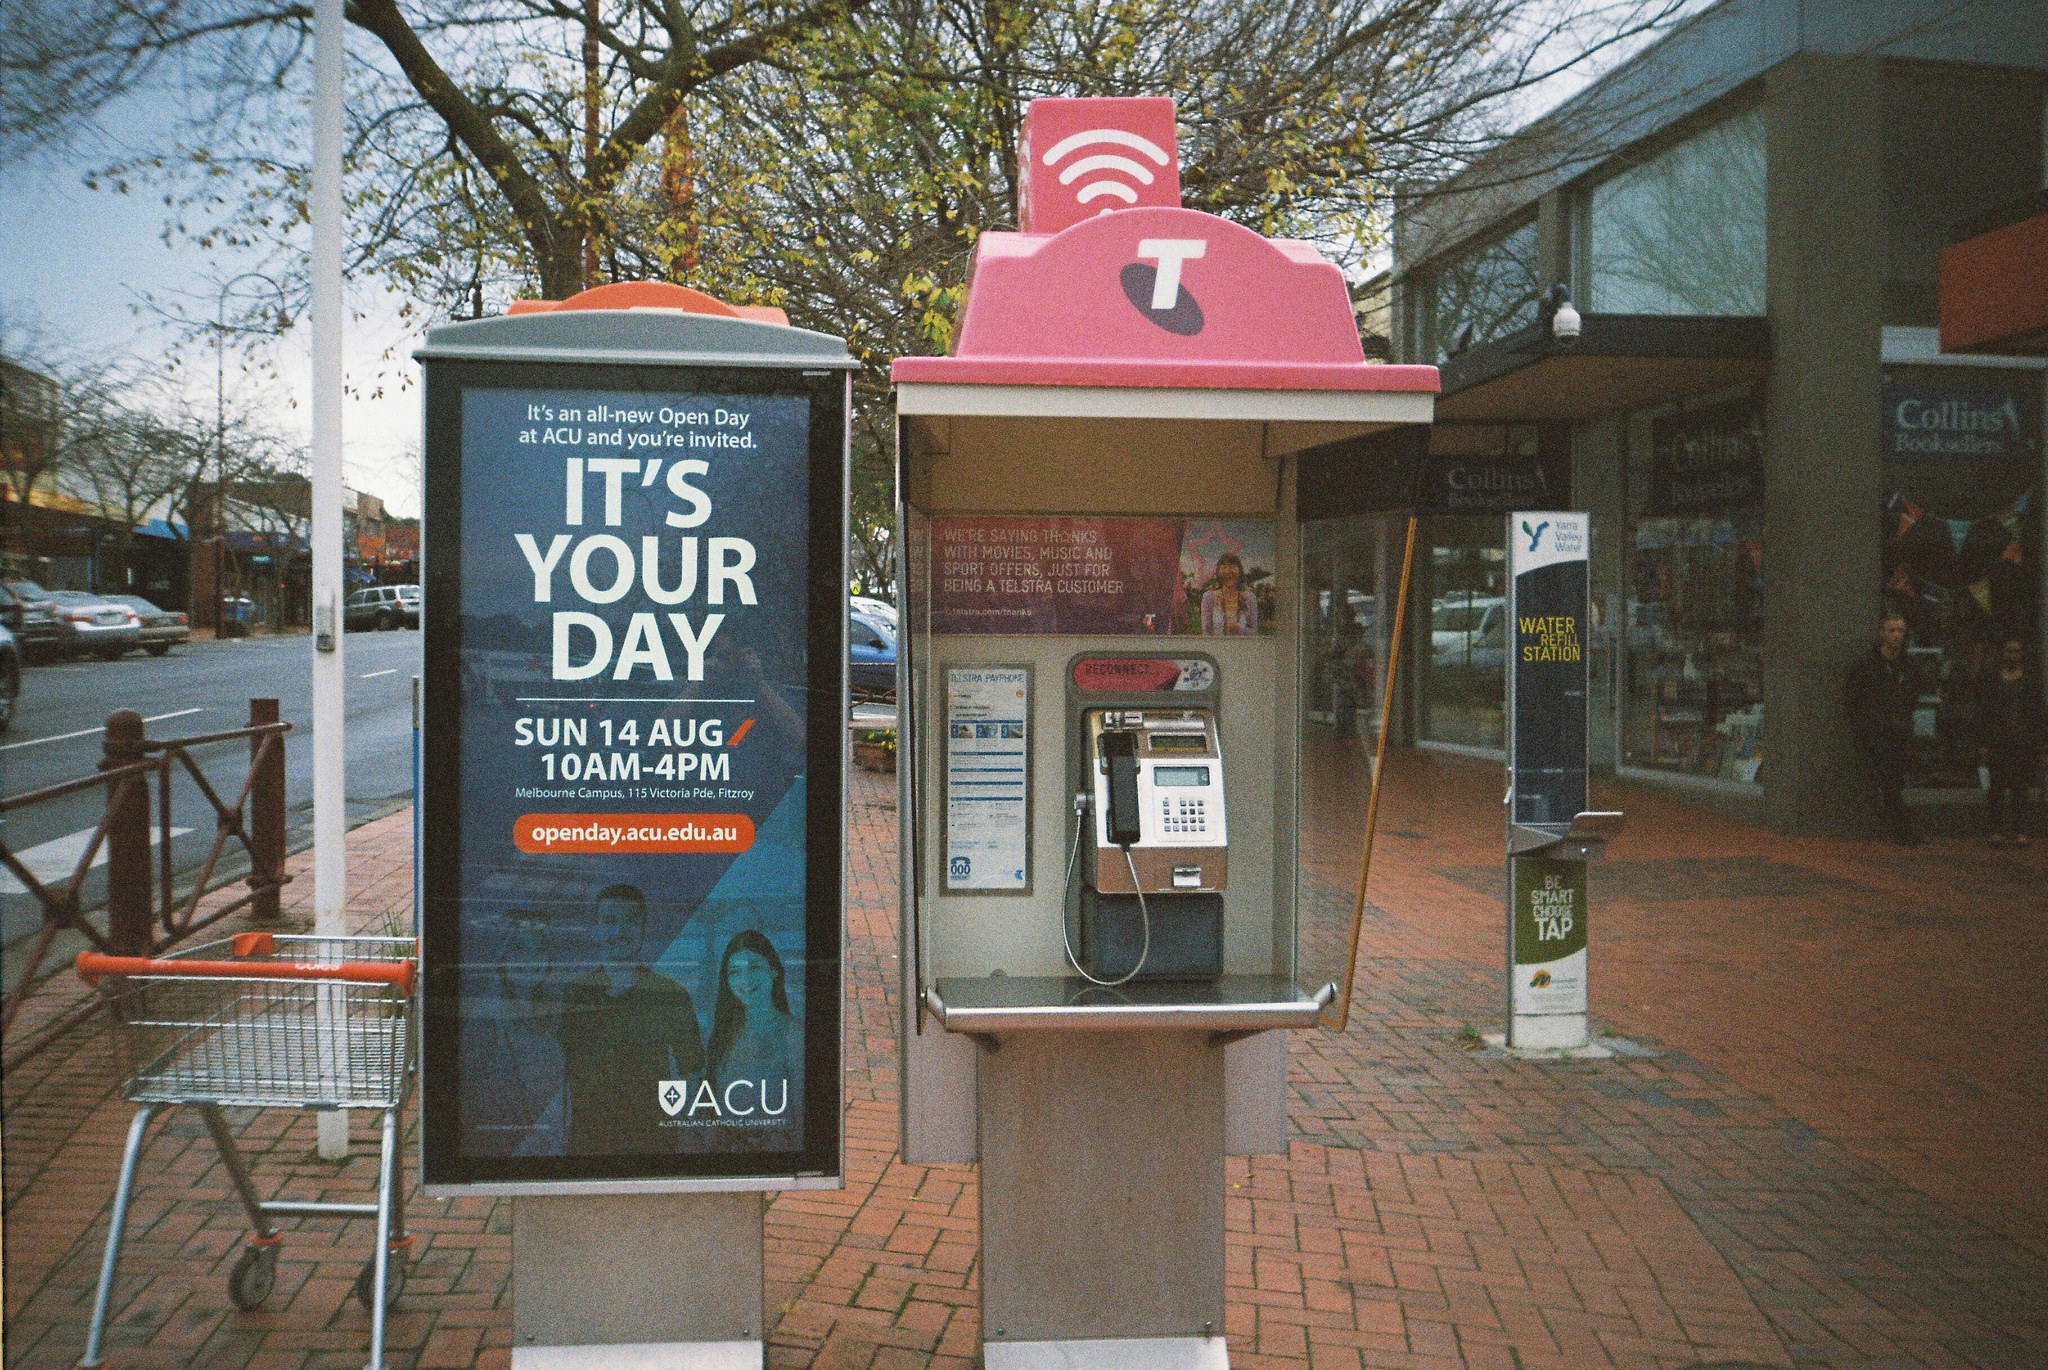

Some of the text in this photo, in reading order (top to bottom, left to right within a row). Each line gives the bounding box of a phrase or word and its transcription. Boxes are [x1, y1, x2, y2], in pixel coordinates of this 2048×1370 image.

[1137, 239, 1206, 309] T
[528, 404, 750, 430] It’s an all-new Open Day
[1897, 400, 2003, 429] Collins
[519, 428, 757, 450] at ACU and you’re invited.
[566, 457, 712, 528] IT’S
[1555, 521, 1578, 530] Yarra
[943, 529, 985, 542] WE'RE
[989, 529, 1038, 542] SAYING
[1555, 531, 1582, 542] Valley
[944, 547, 1112, 561] WITH MOVIES, MUSIC AND
[1554, 542, 1582, 552] Water
[514, 534, 758, 606] YOUR
[943, 564, 1110, 579] SPORT OFFERS, JUST FOR
[943, 579, 1124, 594] BEING A TELSTRA CUSTOMER
[1519, 616, 1575, 634] WATER
[552, 611, 725, 682] DAY
[1540, 633, 1580, 647] REFILL
[1523, 646, 1580, 662] STATION
[514, 717, 722, 747] SUN 14 AUG
[541, 752, 729, 781] 10AM-4PM
[515, 787, 754, 800] Melbourne Campus, 115 Victoria Pde, Fitzroy
[532, 823, 737, 845] openday.acu.edu.au
[951, 865, 971, 875] 000
[1545, 875, 1561, 889] BE
[1531, 889, 1574, 905] SMART
[1535, 917, 1573, 941] TAP
[687, 1079, 787, 1116] ACU
[706, 1119, 744, 1127] CATHOLIC
